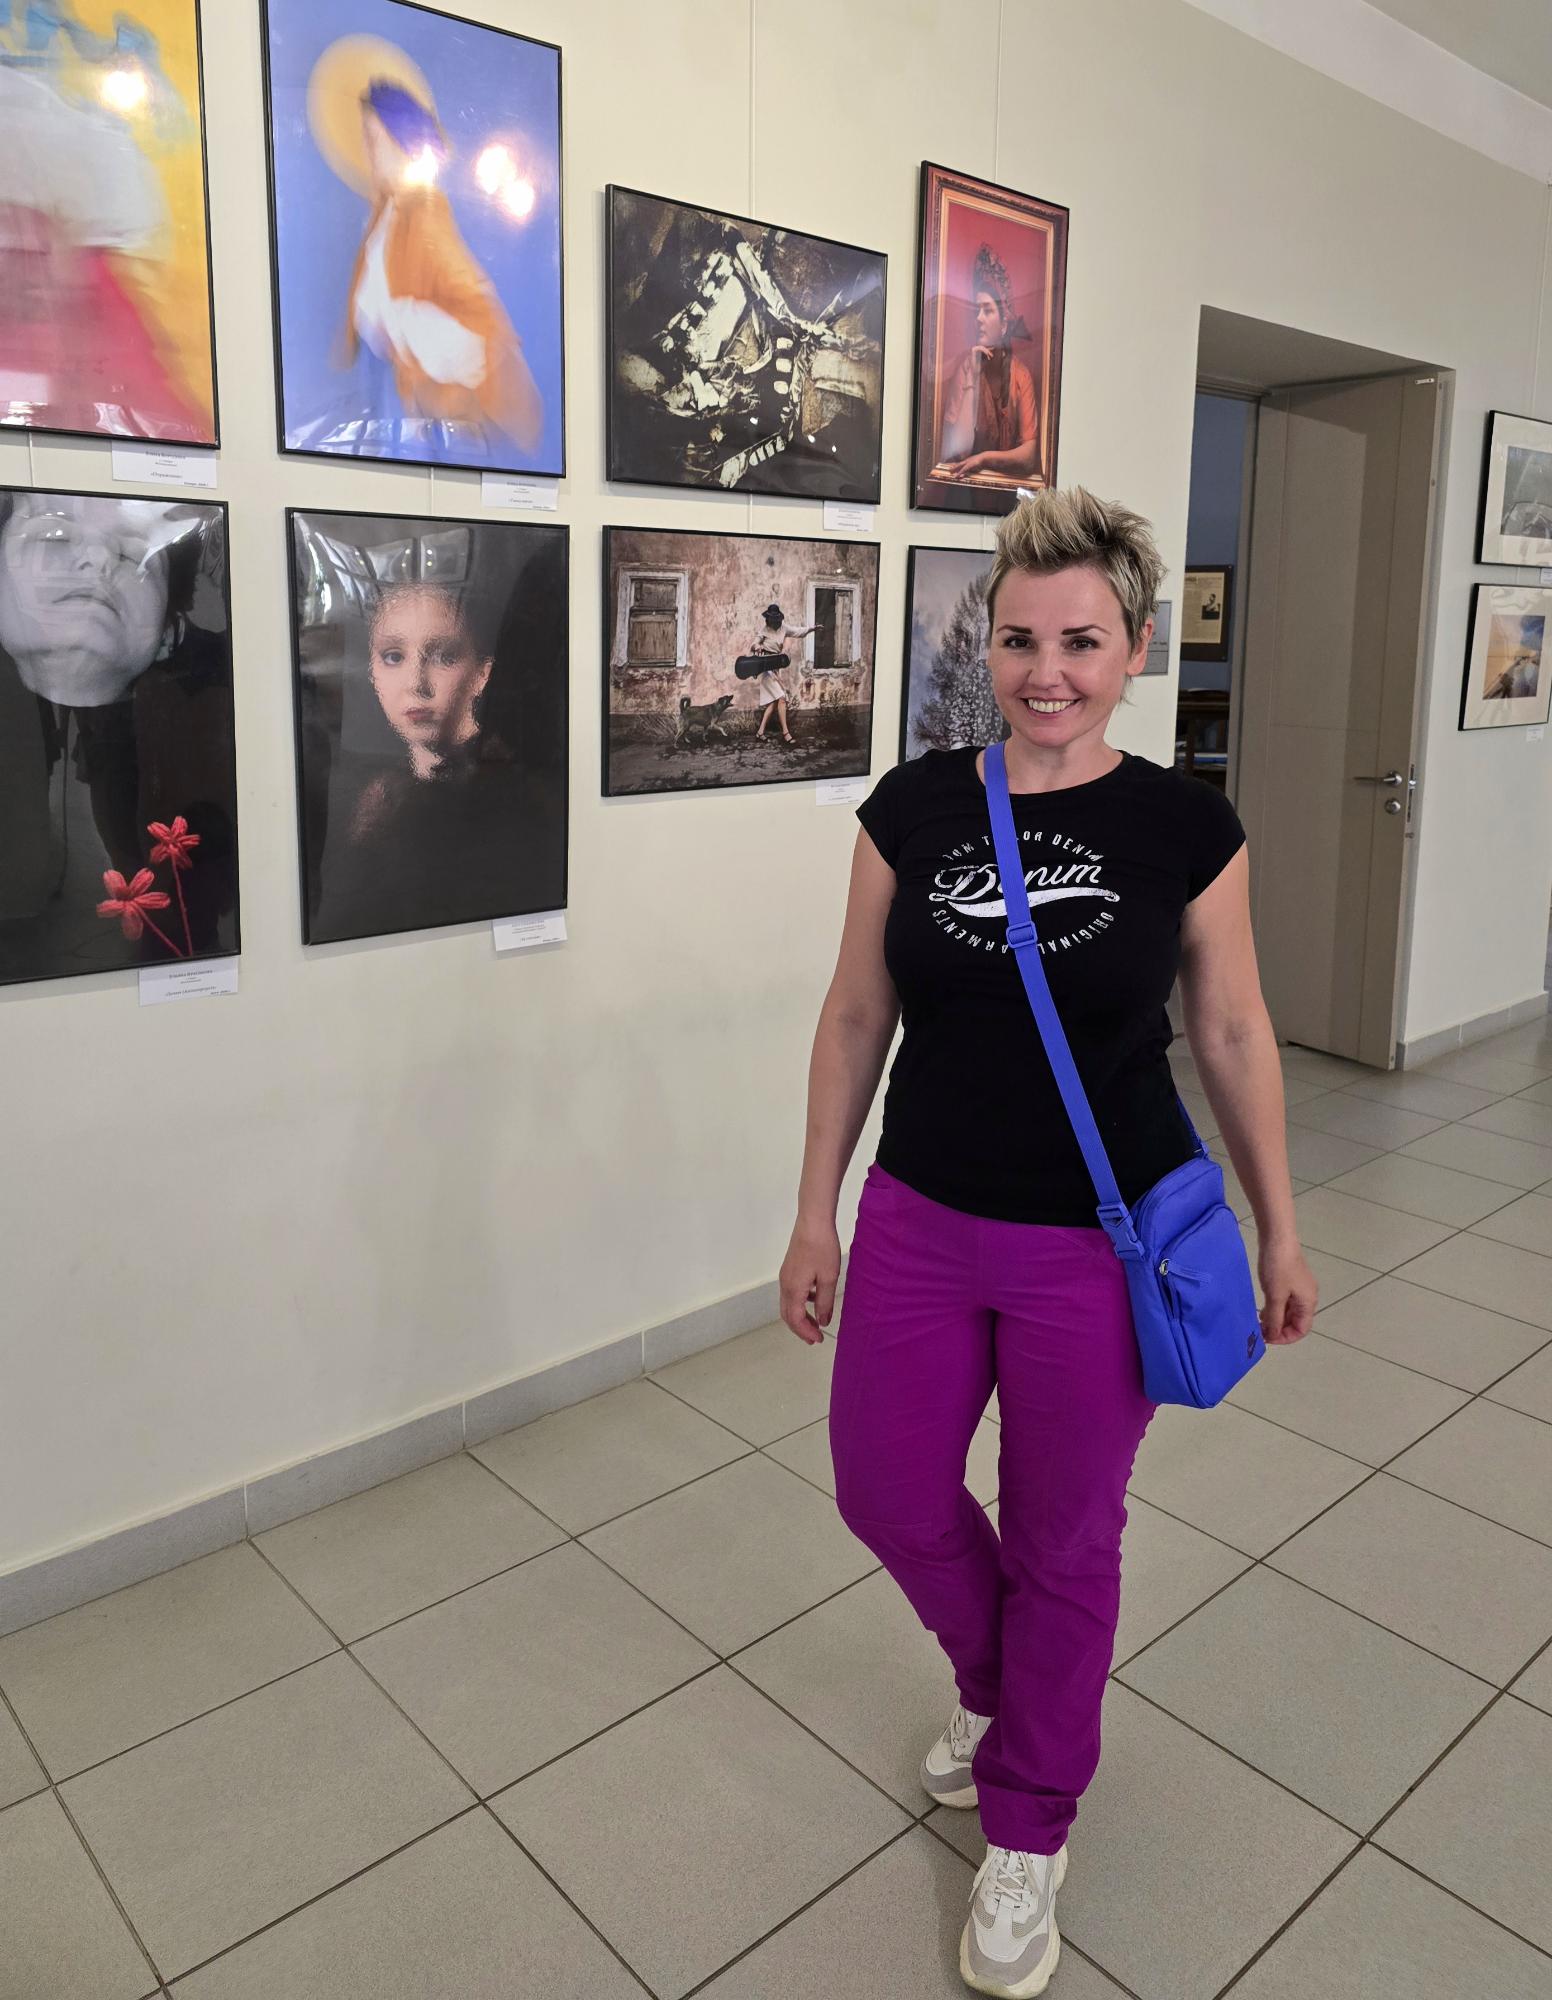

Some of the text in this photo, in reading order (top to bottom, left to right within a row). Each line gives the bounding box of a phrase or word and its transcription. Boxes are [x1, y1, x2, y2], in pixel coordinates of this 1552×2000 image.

[981, 830, 1043, 846] TOR
[1052, 833, 1104, 862] DENIM
[929, 863, 1102, 901] Dnim
[932, 909, 1115, 955] ORIGINAL ARMENTS
